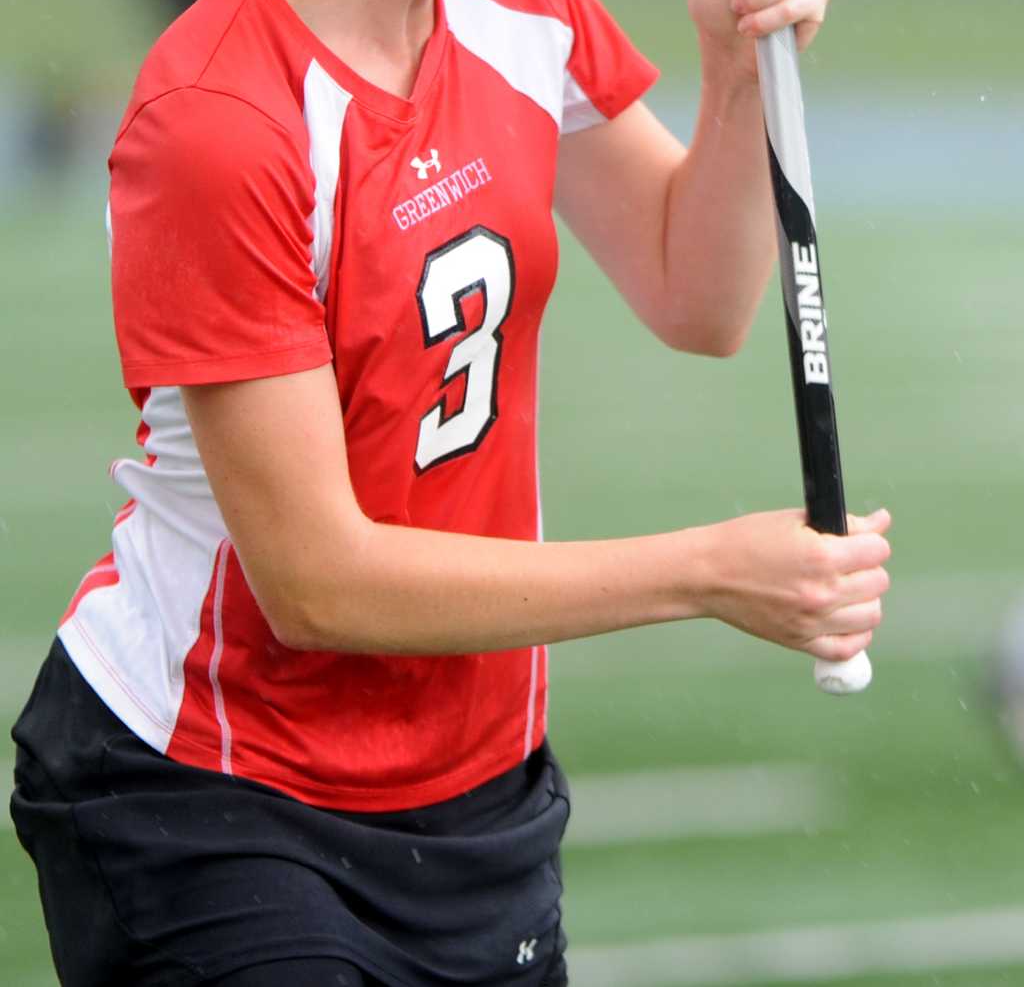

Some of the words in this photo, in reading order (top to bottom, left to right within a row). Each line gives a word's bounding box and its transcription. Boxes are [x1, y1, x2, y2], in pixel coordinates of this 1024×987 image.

[392, 157, 492, 230] GREENWICH
[417, 224, 516, 478] 3
[791, 241, 829, 385] BRINE
